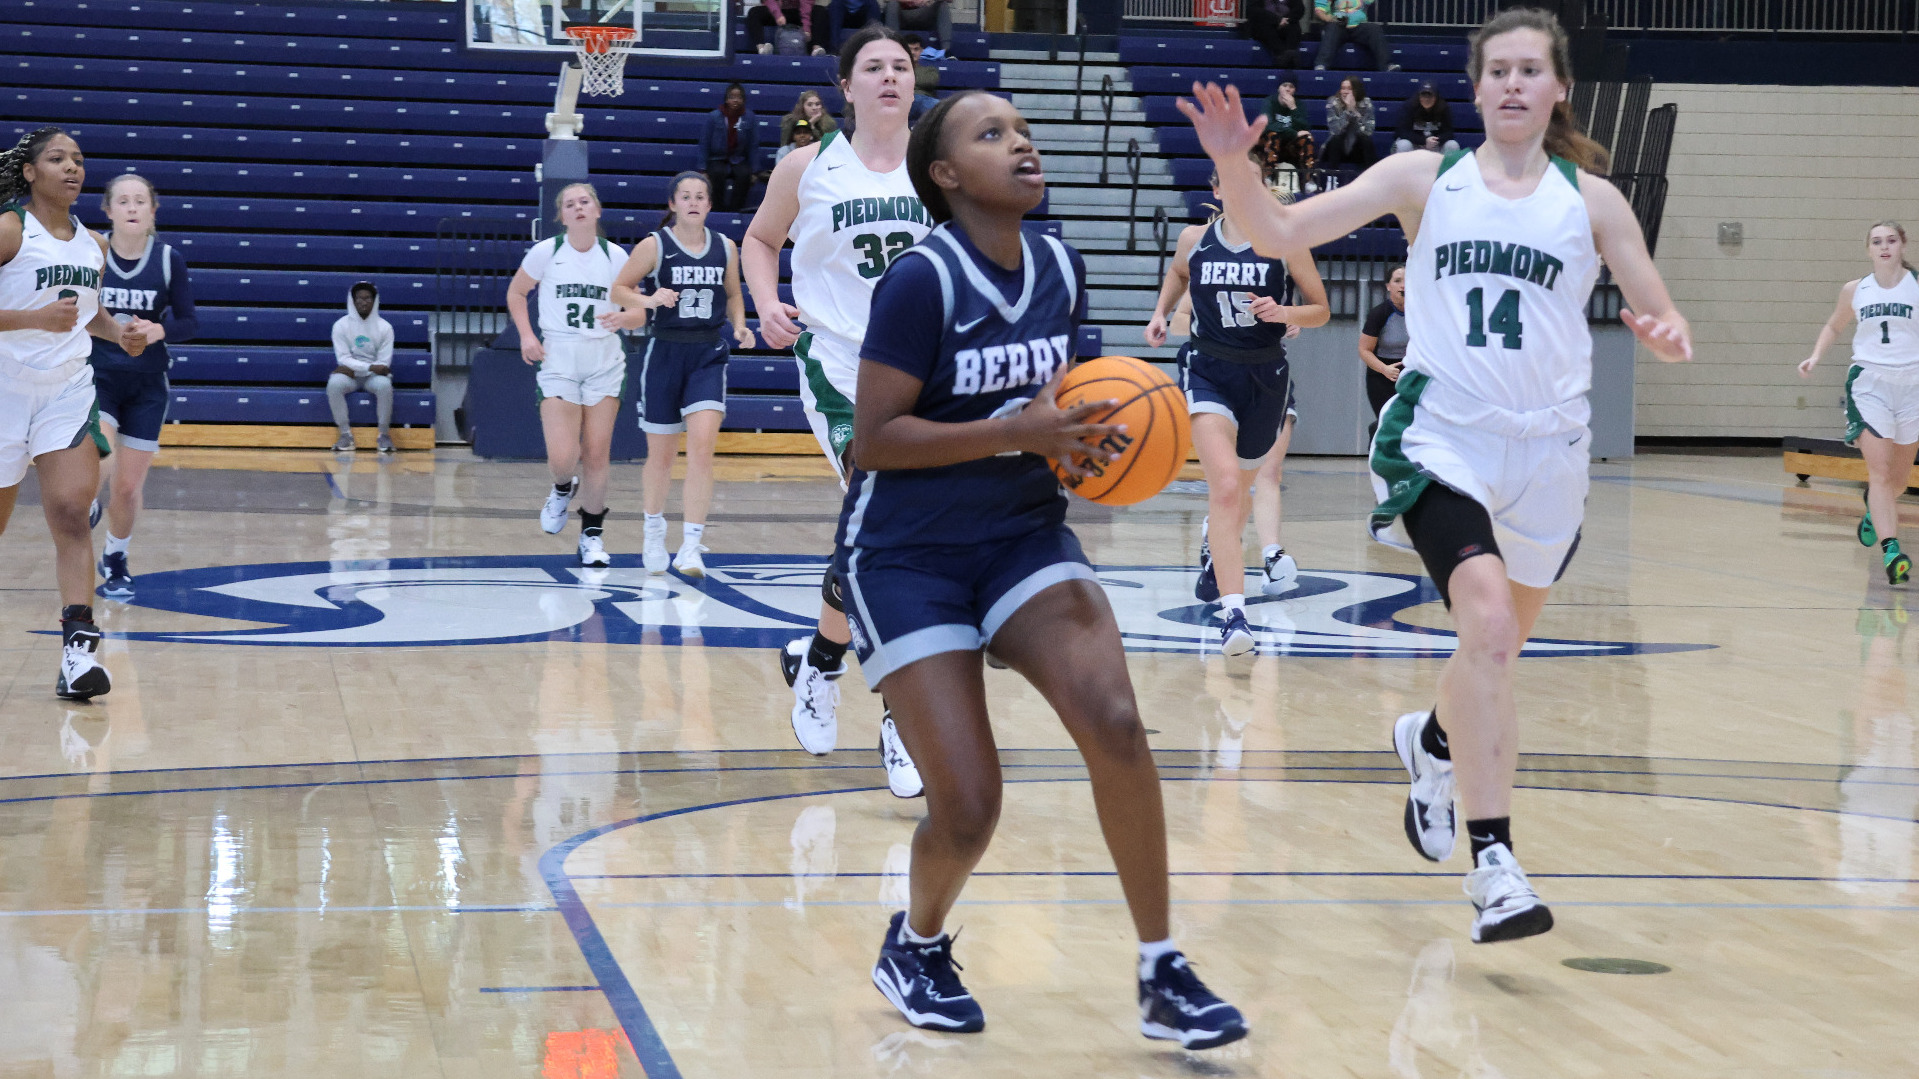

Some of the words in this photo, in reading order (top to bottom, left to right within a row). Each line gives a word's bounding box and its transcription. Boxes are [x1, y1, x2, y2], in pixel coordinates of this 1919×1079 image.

[853, 231, 914, 279] 32
[1435, 240, 1564, 291] PIEDMONT
[671, 266, 725, 285] BERRY
[1200, 262, 1270, 287] BERRY
[100, 287, 157, 310] ERRY
[556, 284, 608, 300] PIEDMONT
[679, 289, 714, 319] 23
[567, 303, 595, 329] 24
[1216, 291, 1258, 328] 15
[1466, 287, 1523, 350] 14
[1860, 303, 1913, 321] PIEDMONT
[1880, 321, 1890, 344] 1
